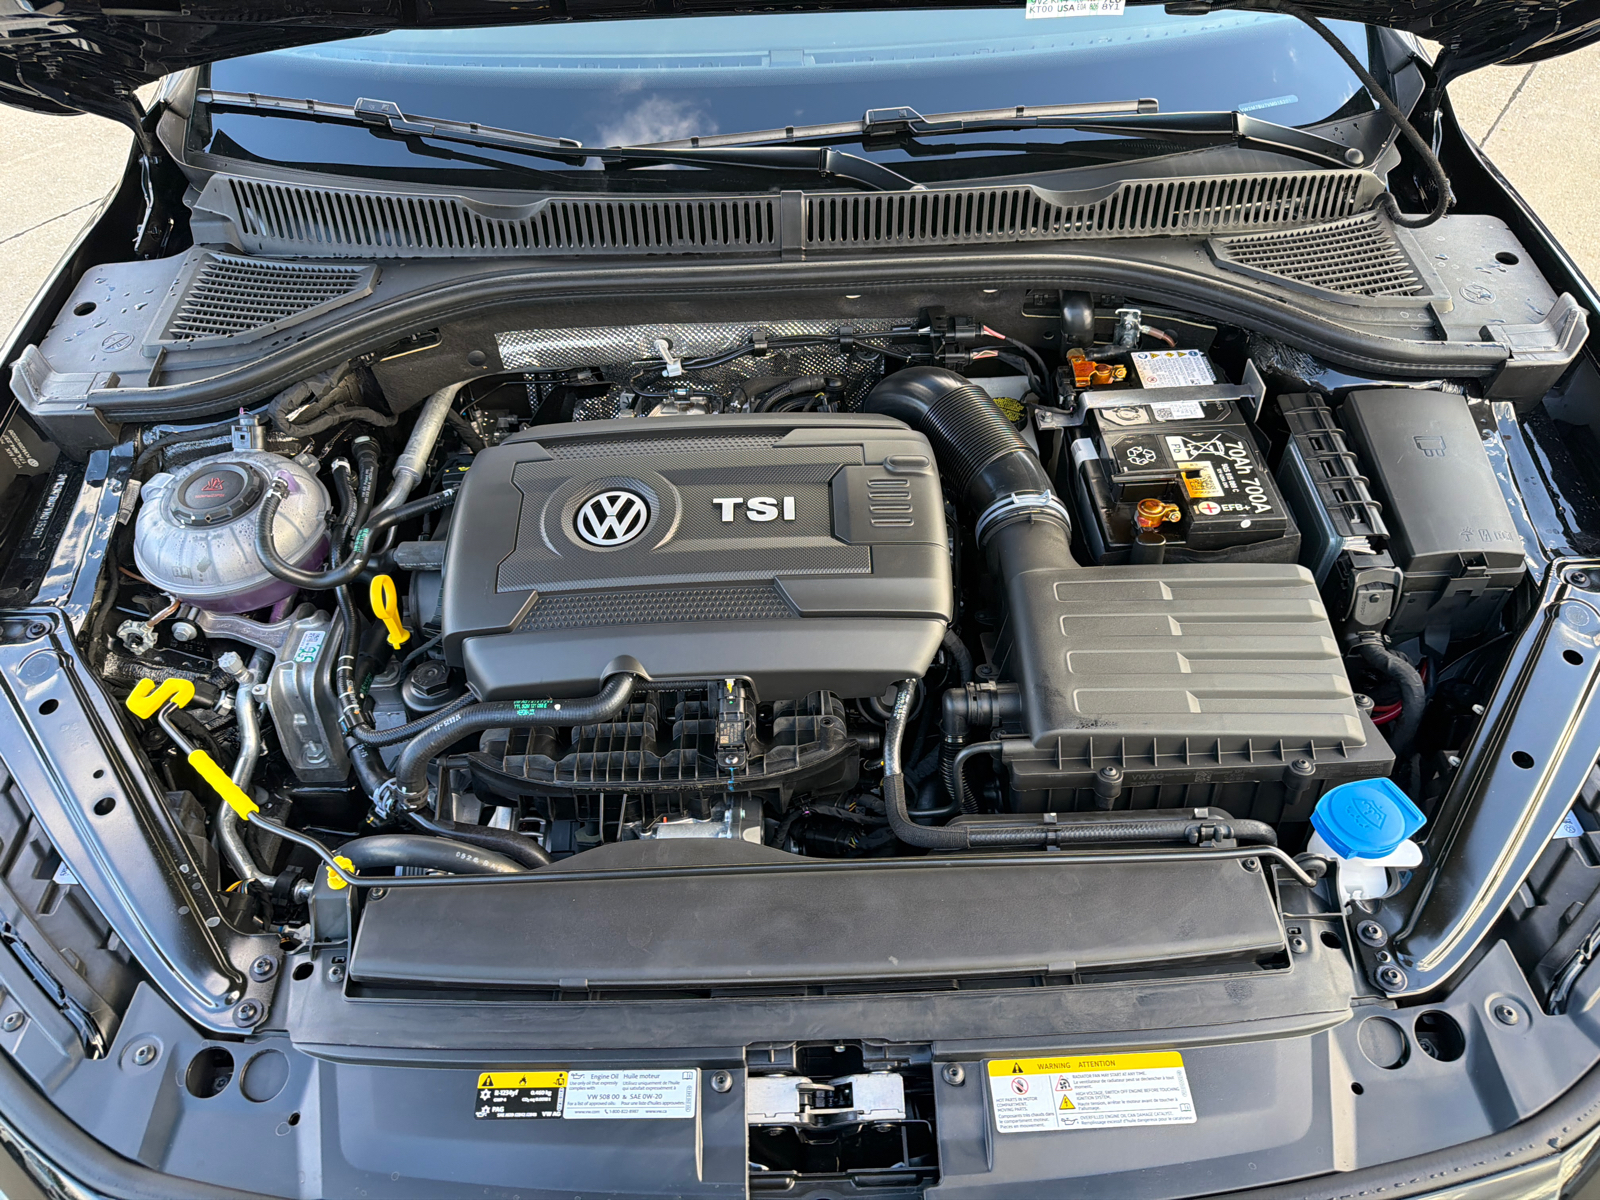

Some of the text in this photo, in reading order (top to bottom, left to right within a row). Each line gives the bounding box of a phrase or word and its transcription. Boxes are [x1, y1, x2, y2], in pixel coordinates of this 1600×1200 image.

[1058, 4, 1075, 12] USA
[1225, 442, 1272, 514] 70Ah 700A
[713, 496, 795, 522] TSI
[1221, 503, 1251, 511] EFB+
[1037, 1060, 1116, 1070] WARNING ATTENTION
